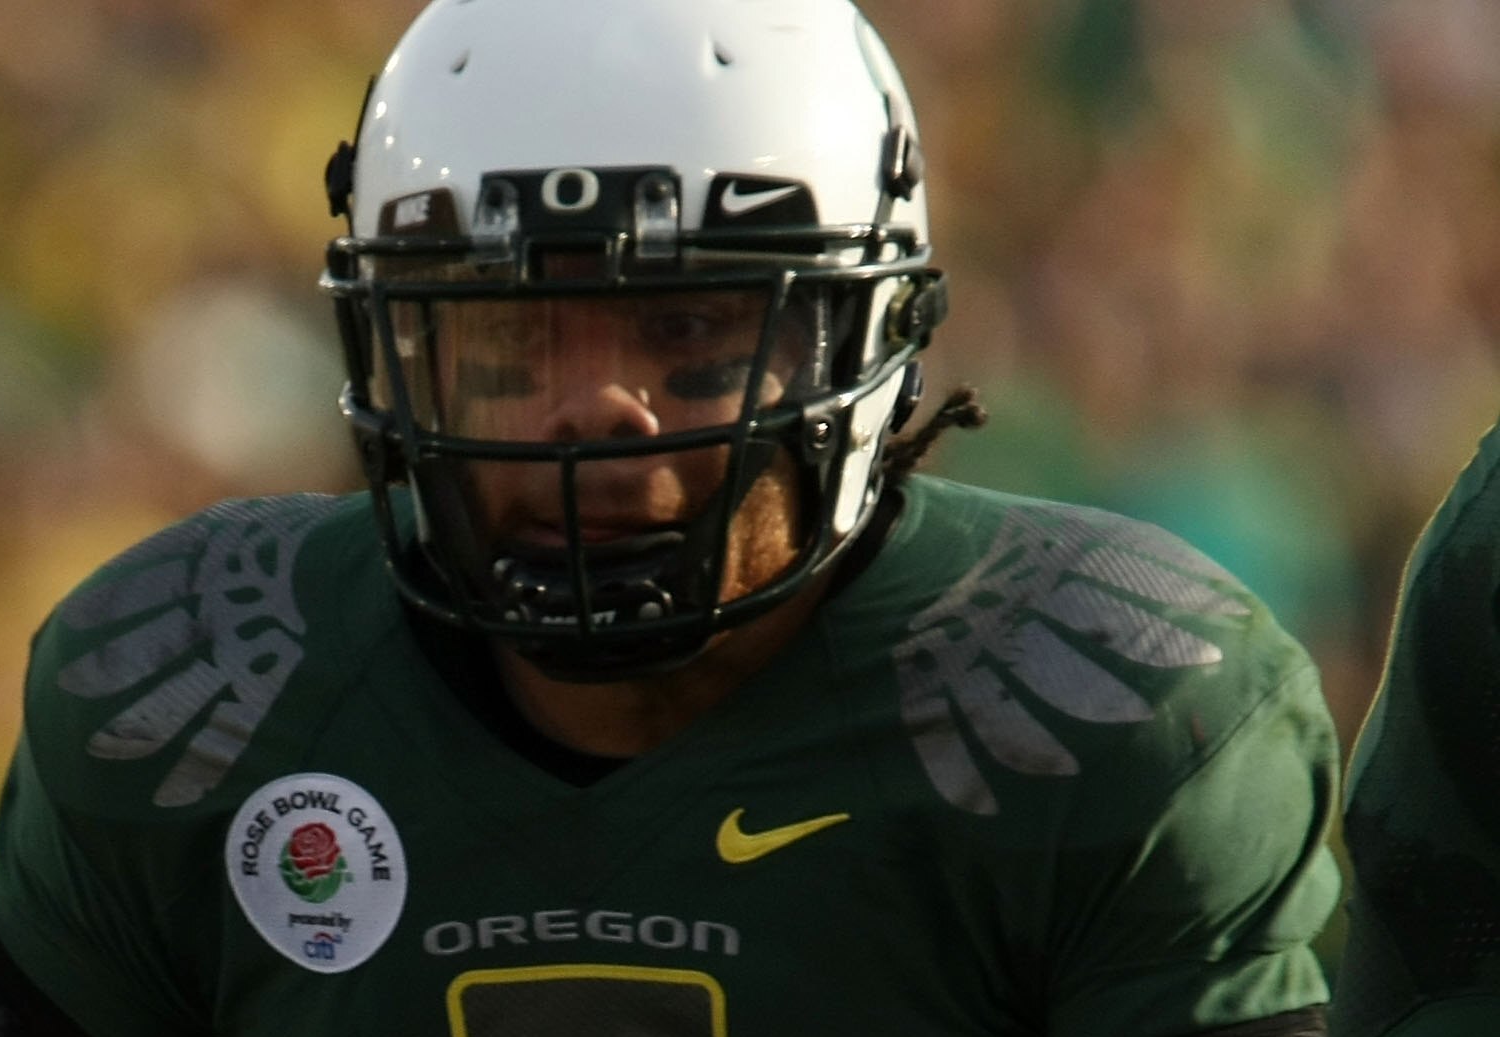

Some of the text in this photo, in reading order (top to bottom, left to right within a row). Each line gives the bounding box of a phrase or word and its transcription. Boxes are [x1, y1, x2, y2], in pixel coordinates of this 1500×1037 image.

[541, 168, 599, 210] O
[241, 790, 391, 881] ROSE BOWL GAME
[423, 910, 740, 956] OREGON
